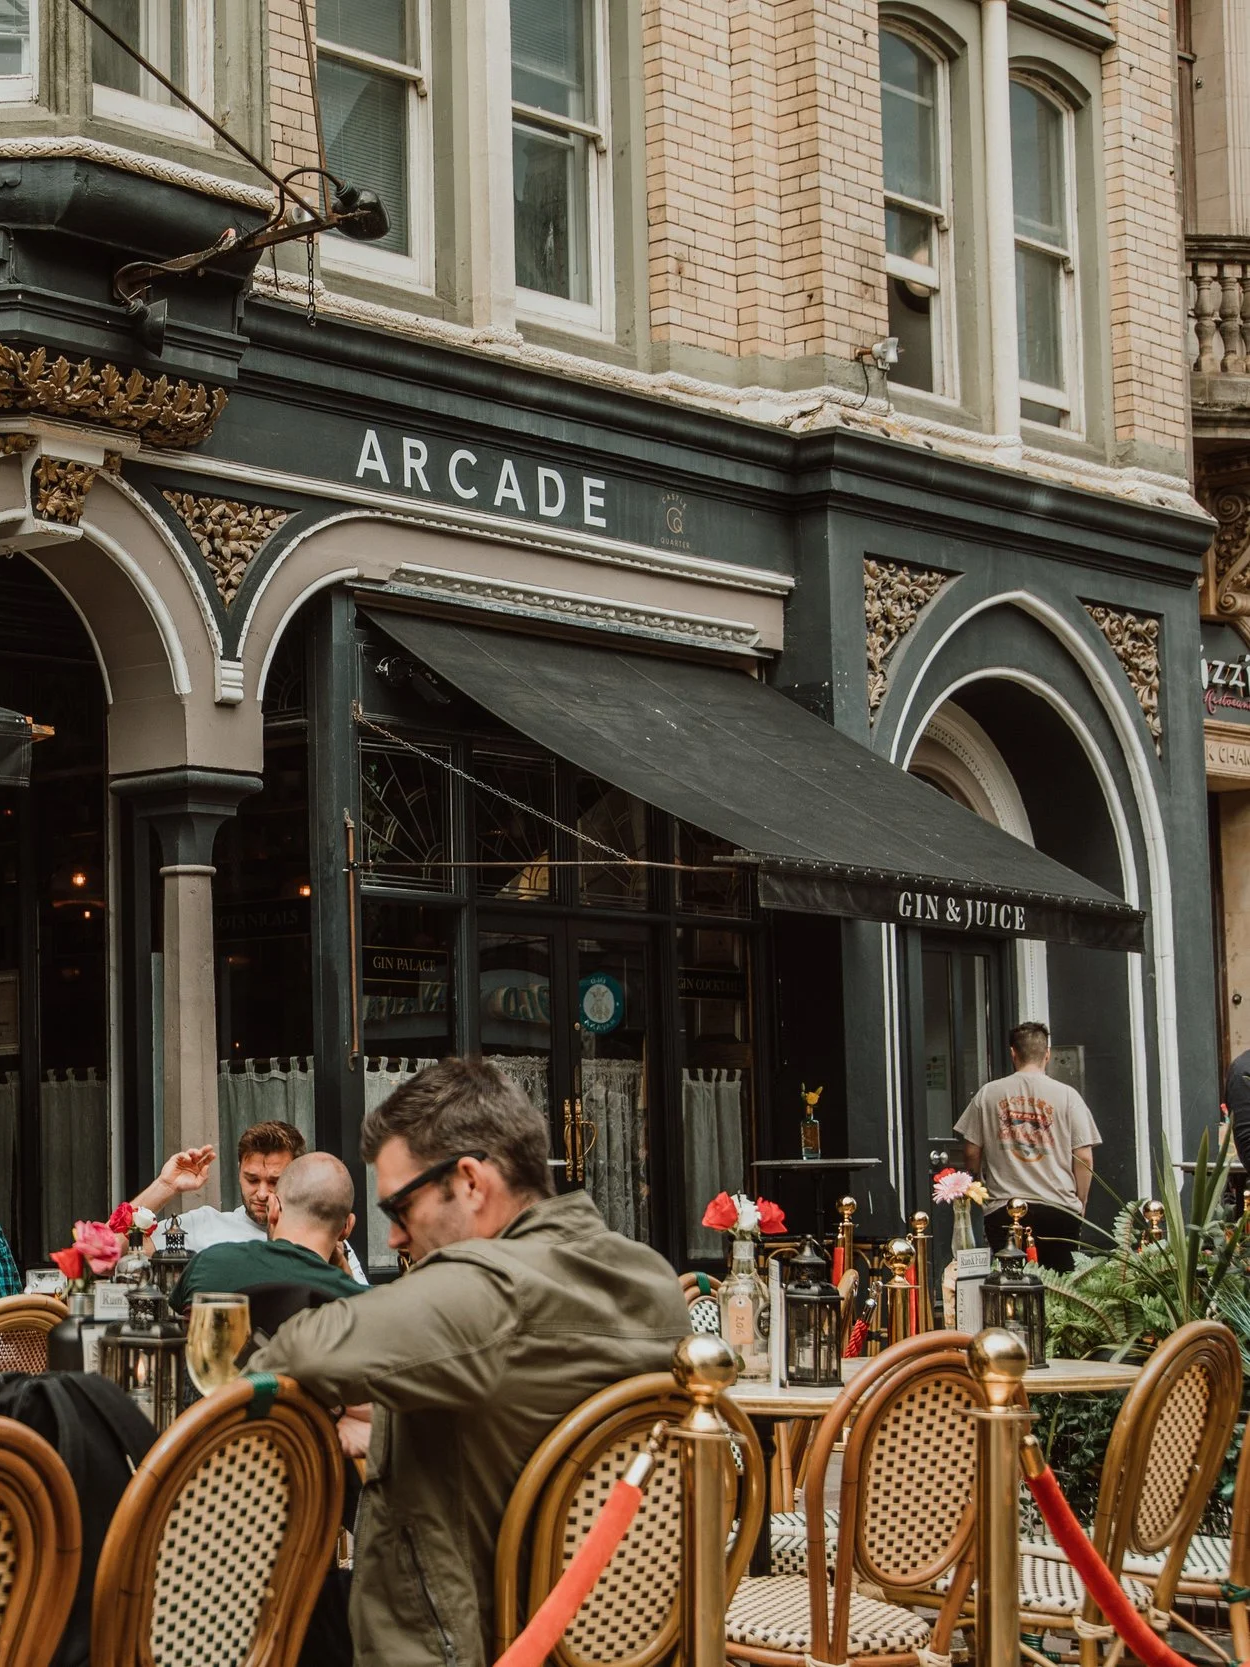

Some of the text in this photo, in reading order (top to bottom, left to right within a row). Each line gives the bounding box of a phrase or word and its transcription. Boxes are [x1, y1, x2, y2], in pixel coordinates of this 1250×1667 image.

[355, 429, 607, 528] ARCADE
[661, 493, 688, 510] CASTLE
[660, 537, 691, 549] QUARTER
[898, 891, 1026, 931] GIN & JUICE
[373, 956, 437, 972] GIN PALACE
